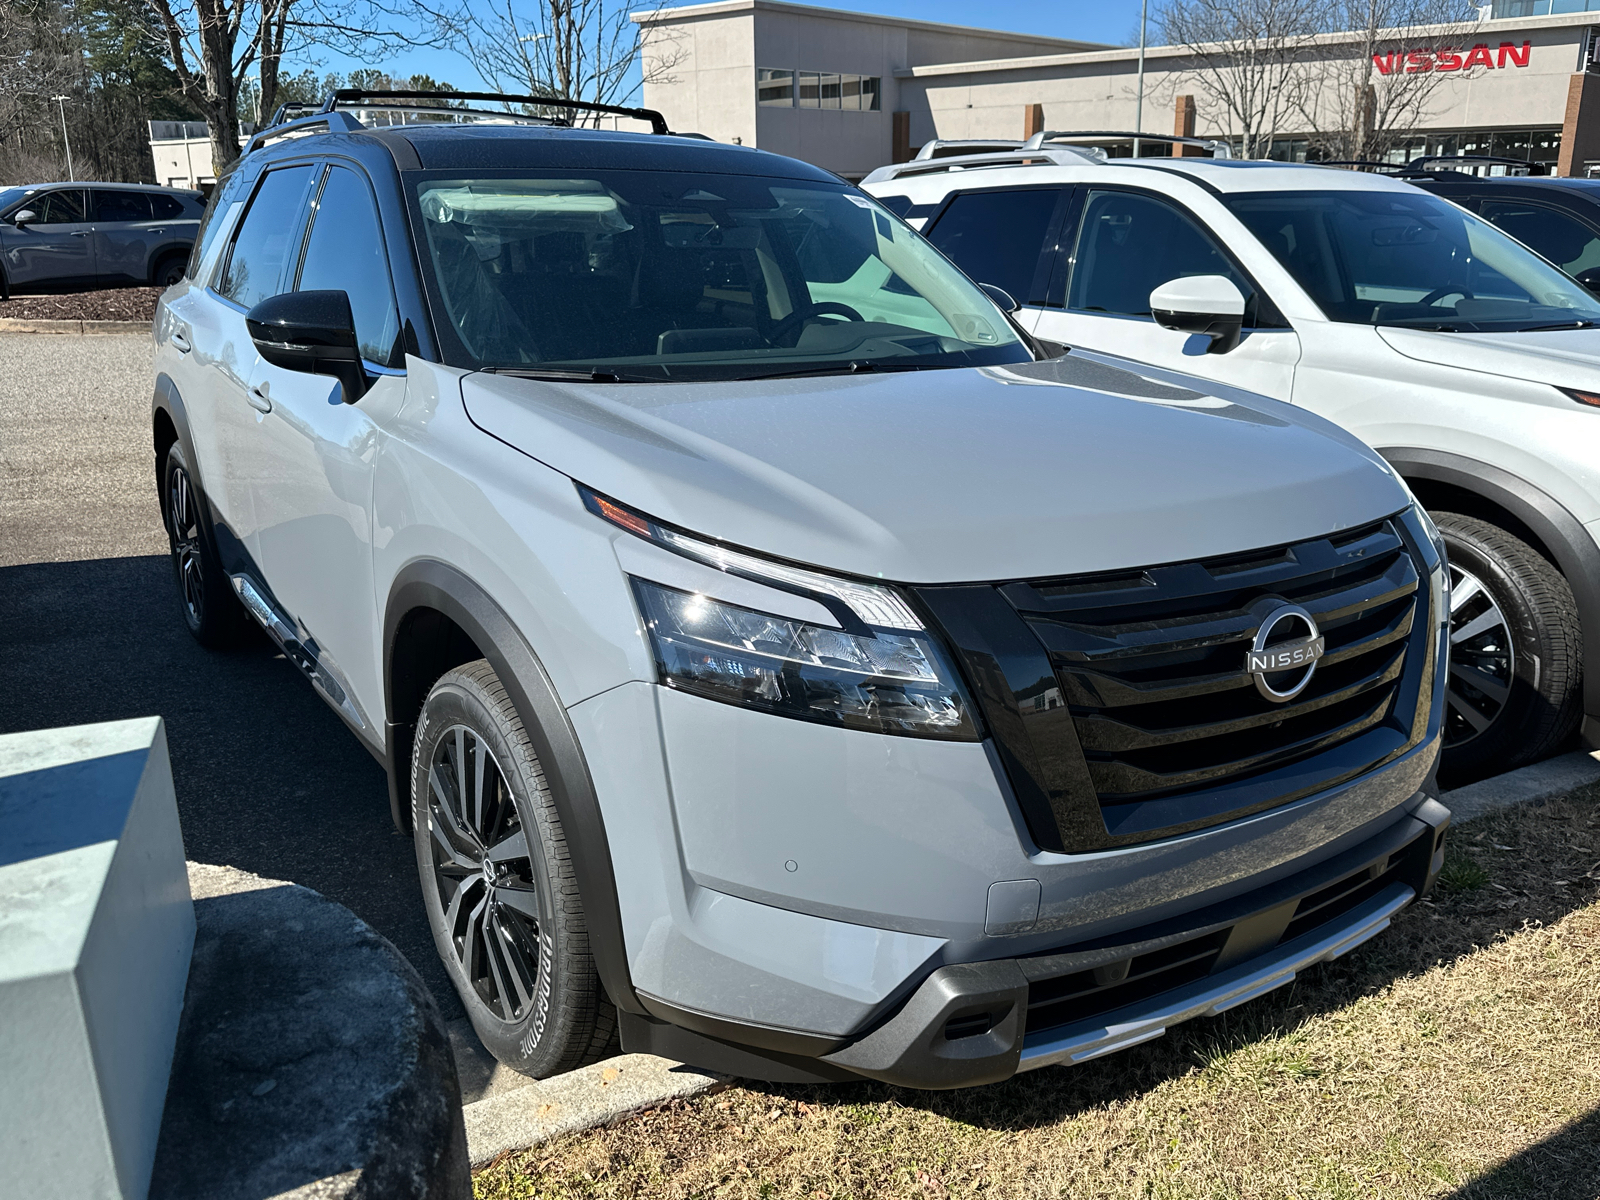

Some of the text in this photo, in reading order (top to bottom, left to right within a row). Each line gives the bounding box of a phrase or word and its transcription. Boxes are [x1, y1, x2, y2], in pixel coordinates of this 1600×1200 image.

[1372, 40, 1531, 75] NISSAN
[1252, 643, 1323, 670] NISSAN
[519, 930, 553, 1060] BRIDGESTONE
